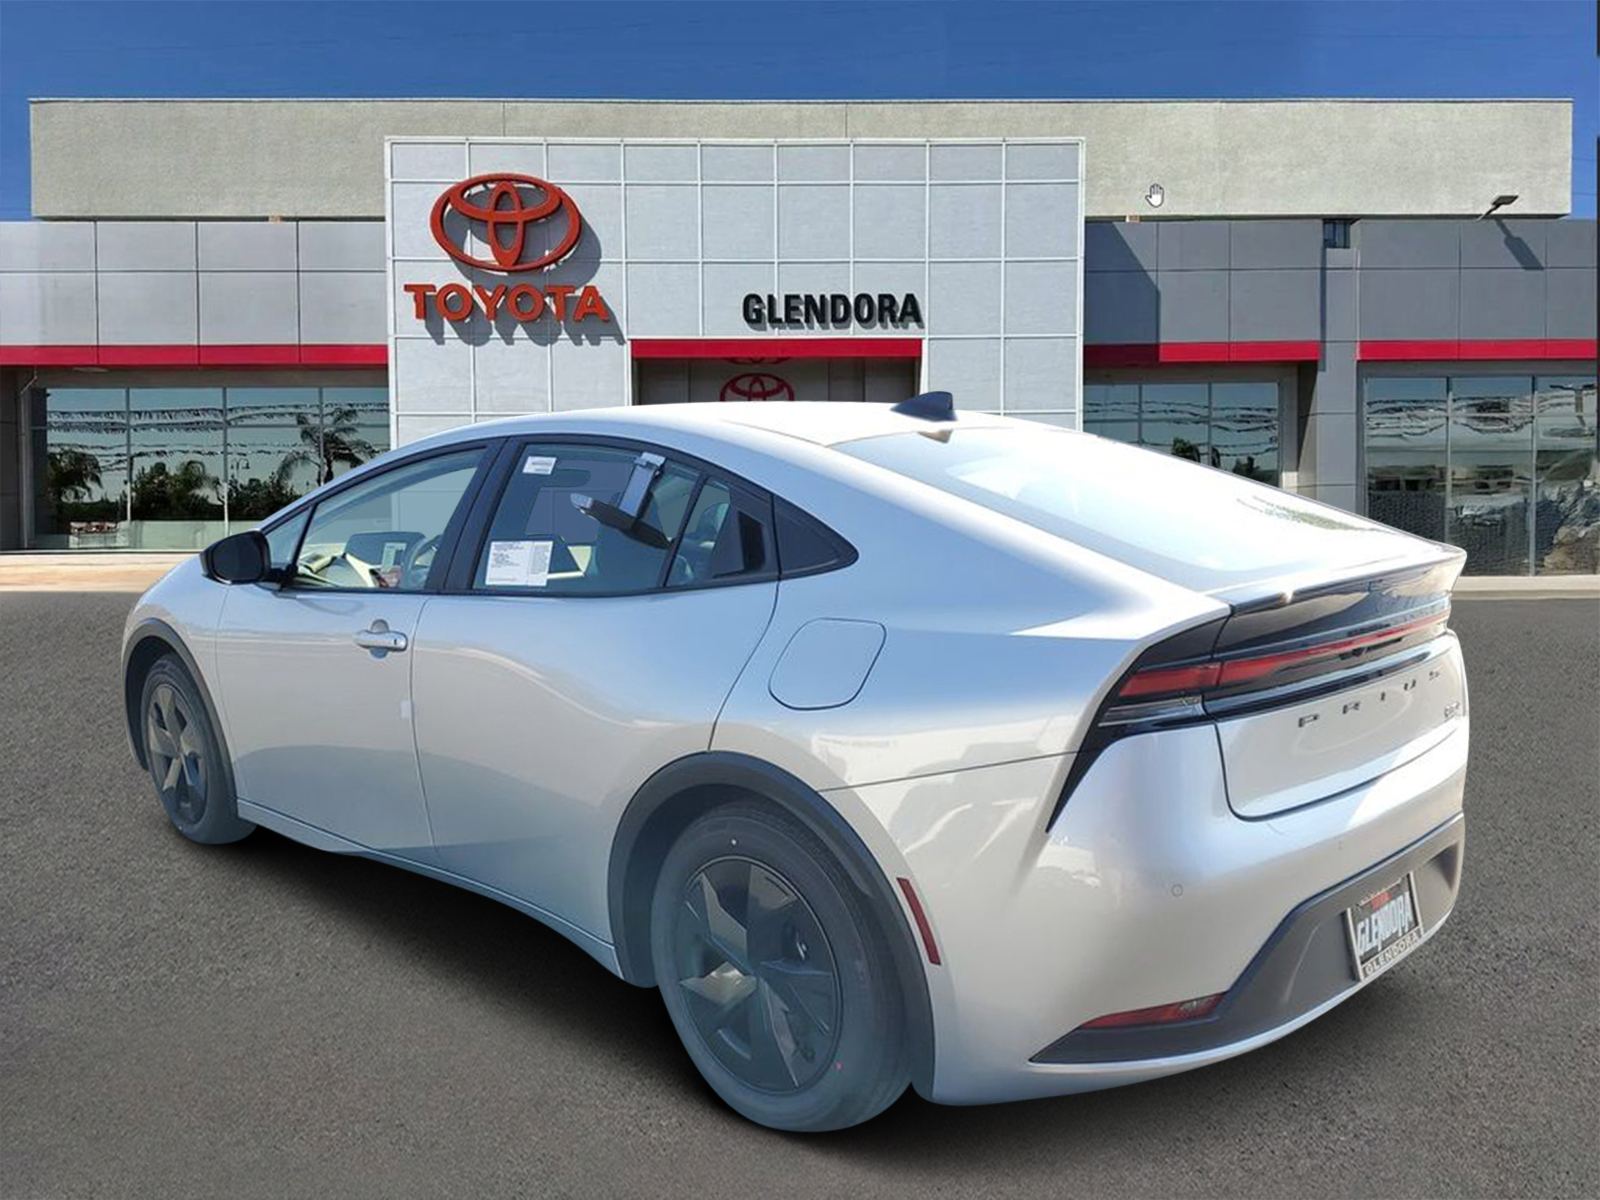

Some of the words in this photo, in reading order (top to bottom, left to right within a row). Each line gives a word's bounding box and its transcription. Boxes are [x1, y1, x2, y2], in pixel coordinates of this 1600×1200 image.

[404, 283, 610, 322] TOYOTA
[743, 293, 922, 324] GLENDORA
[1356, 891, 1413, 956] GLENDORA
[1365, 932, 1420, 975] GLENDORA
